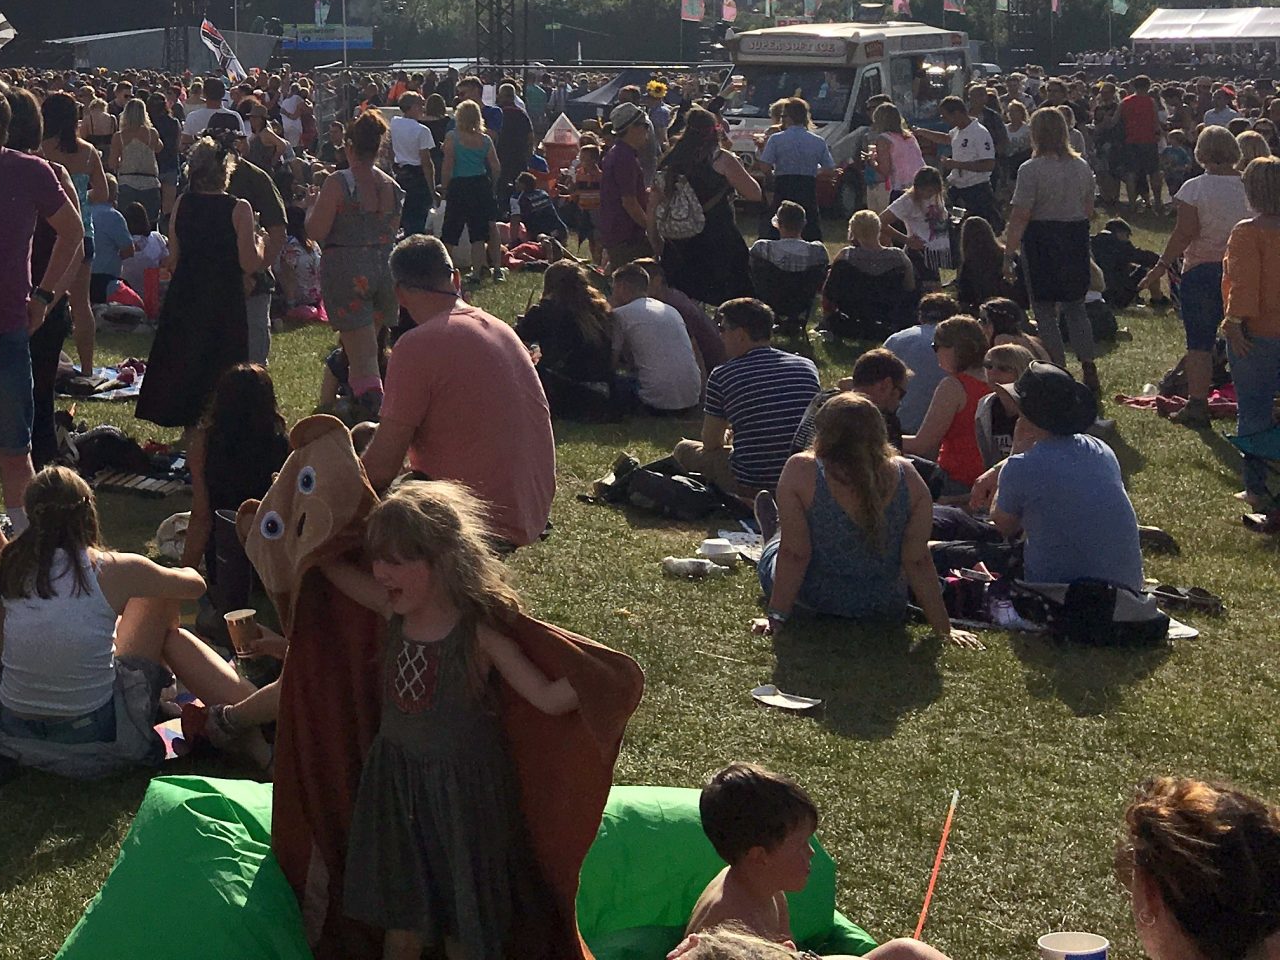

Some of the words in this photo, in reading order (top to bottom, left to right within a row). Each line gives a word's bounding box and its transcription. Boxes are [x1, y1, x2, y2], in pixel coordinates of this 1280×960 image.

[748, 41, 782, 53] SUPER
[785, 41, 812, 53] SOFT
[813, 42, 836, 54] ICE
[961, 138, 969, 147] 3
[984, 142, 991, 151] 3
